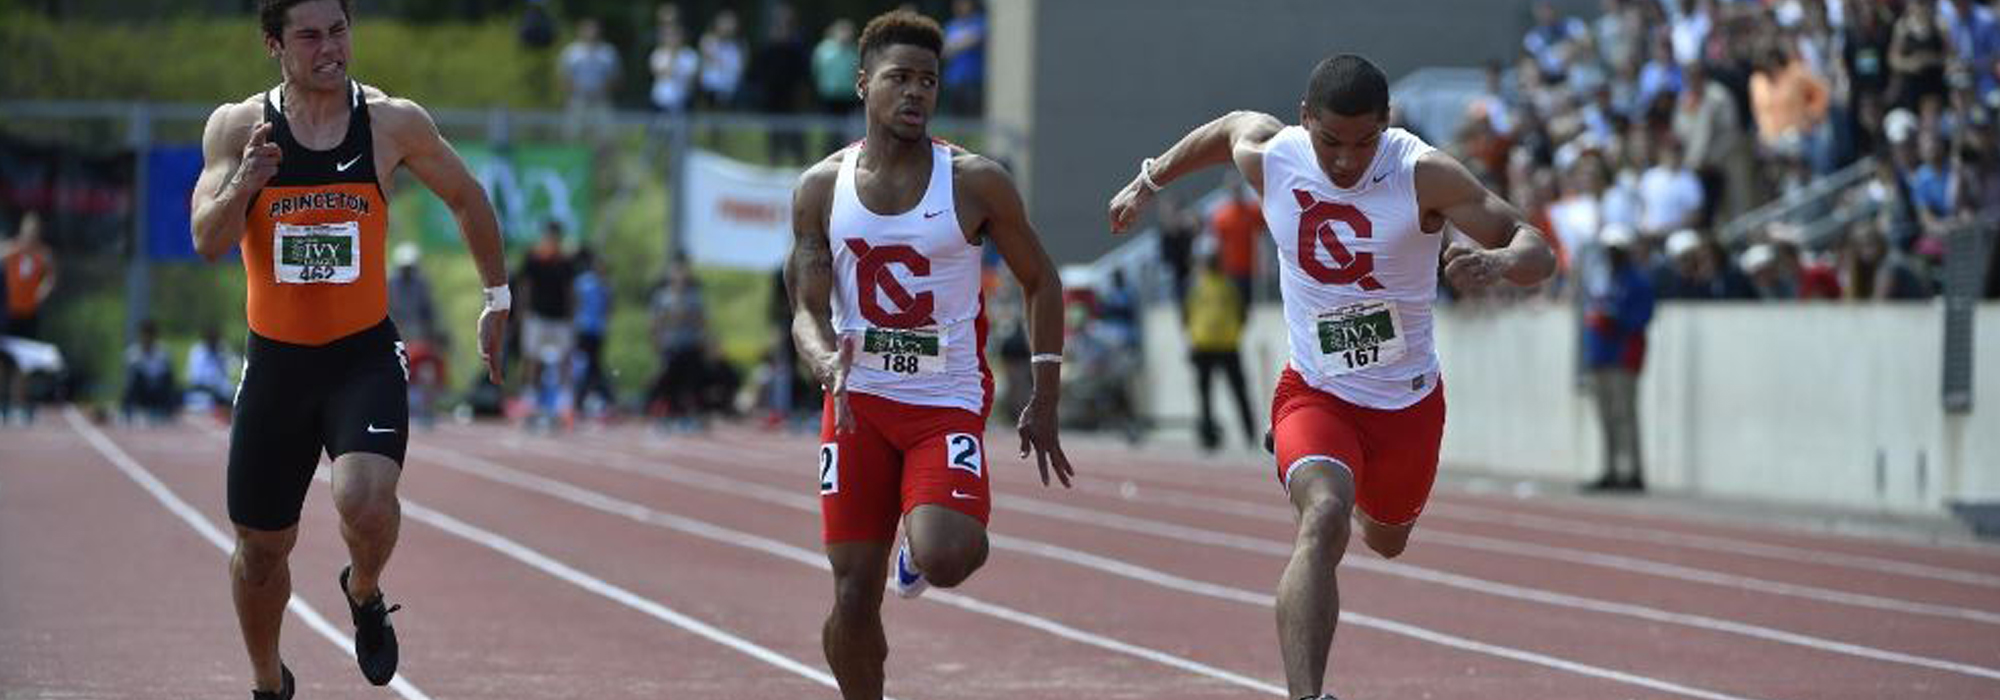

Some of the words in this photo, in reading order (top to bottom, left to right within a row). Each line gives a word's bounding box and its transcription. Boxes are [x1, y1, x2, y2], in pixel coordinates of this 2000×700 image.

[269, 192, 370, 218] PRINCETON
[304, 243, 340, 258] IVY
[882, 353, 919, 374] 188
[1343, 346, 1380, 369] 167
[951, 435, 978, 471] 2
